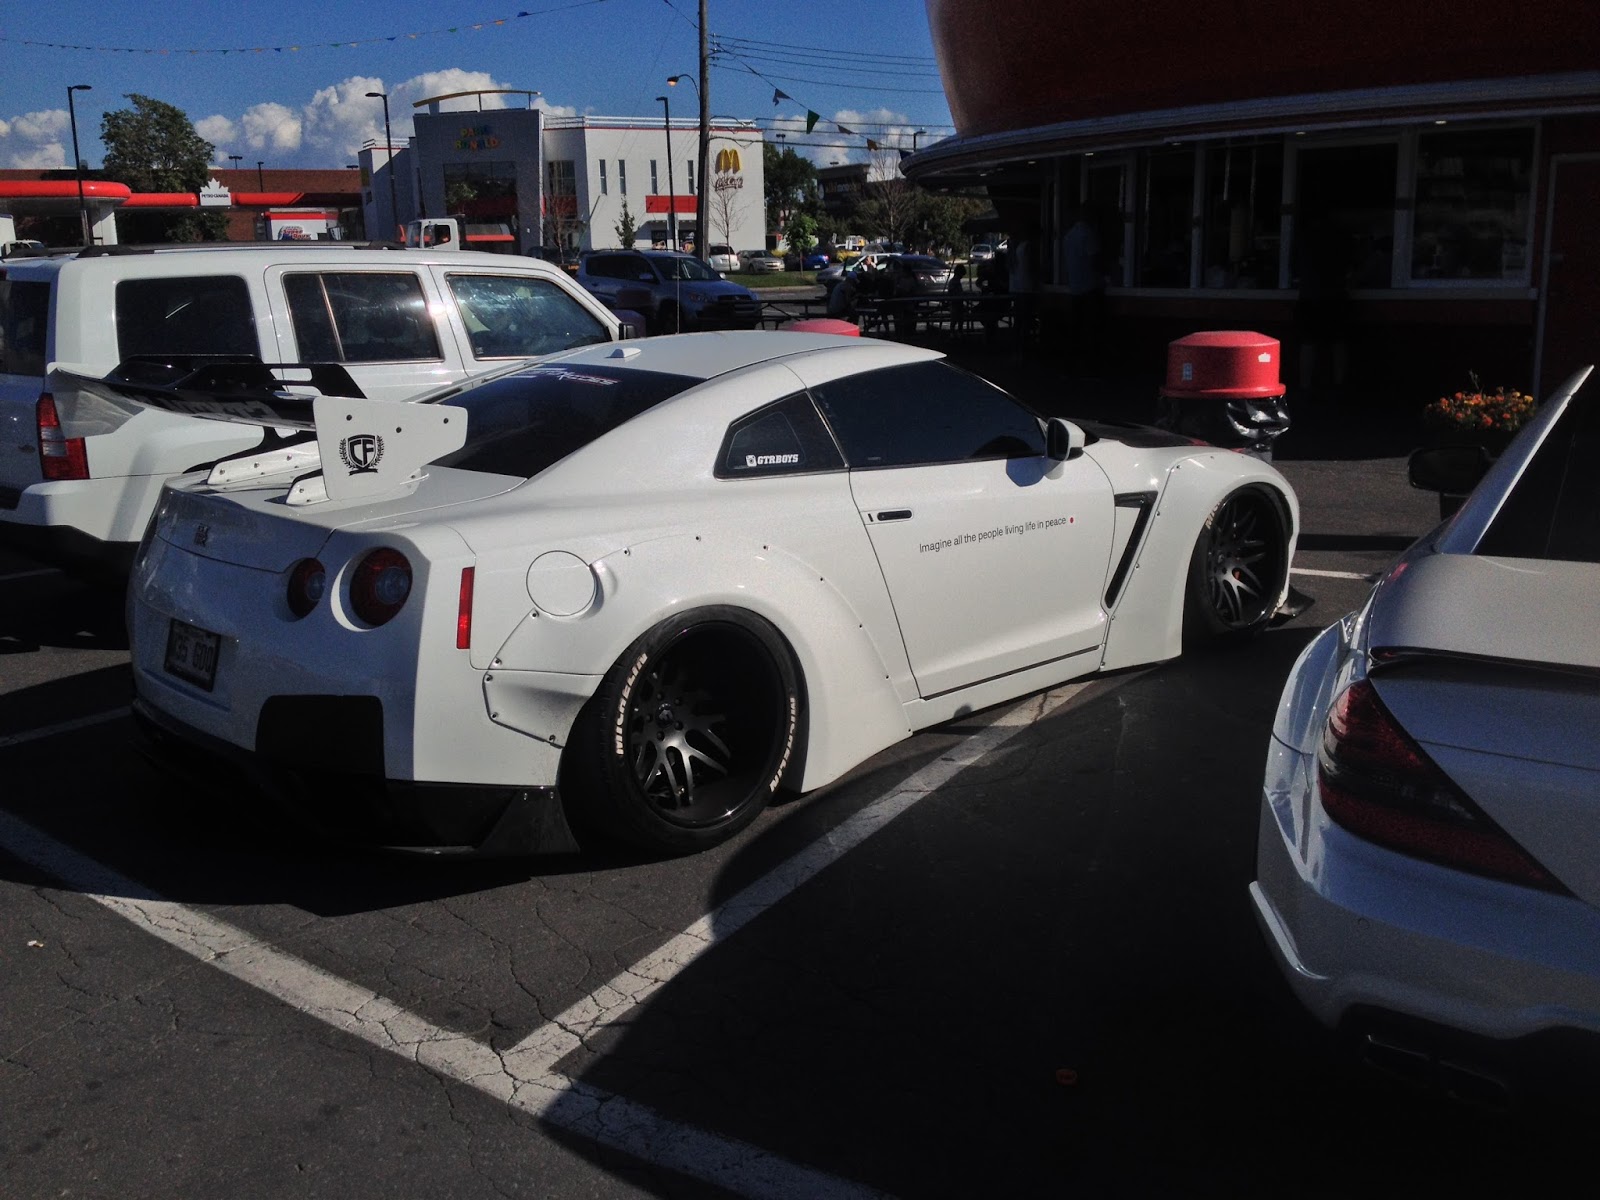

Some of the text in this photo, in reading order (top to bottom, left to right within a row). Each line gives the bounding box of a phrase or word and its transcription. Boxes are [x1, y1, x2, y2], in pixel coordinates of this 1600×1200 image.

[350, 438, 375, 466] CF
[757, 454, 799, 465] GTRBOYS
[919, 516, 1067, 553] Imagine all the people living life in peace
[615, 653, 648, 755] MICHELIN
[769, 697, 797, 793] MICHELIN
